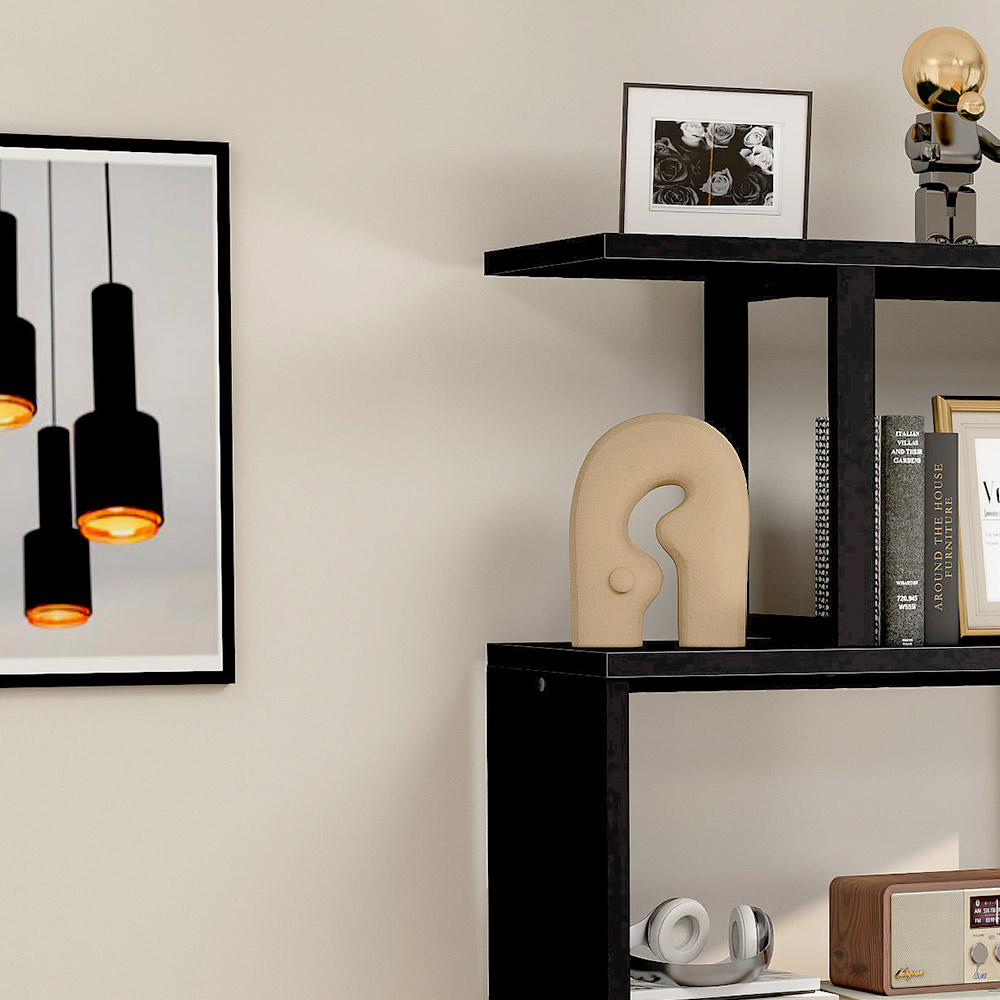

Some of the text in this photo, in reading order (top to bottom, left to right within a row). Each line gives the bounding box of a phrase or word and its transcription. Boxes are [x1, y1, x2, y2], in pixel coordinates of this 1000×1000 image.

[934, 463, 943, 611] AROUND THE HOUSE
[945, 496, 953, 578] FURNITURE
